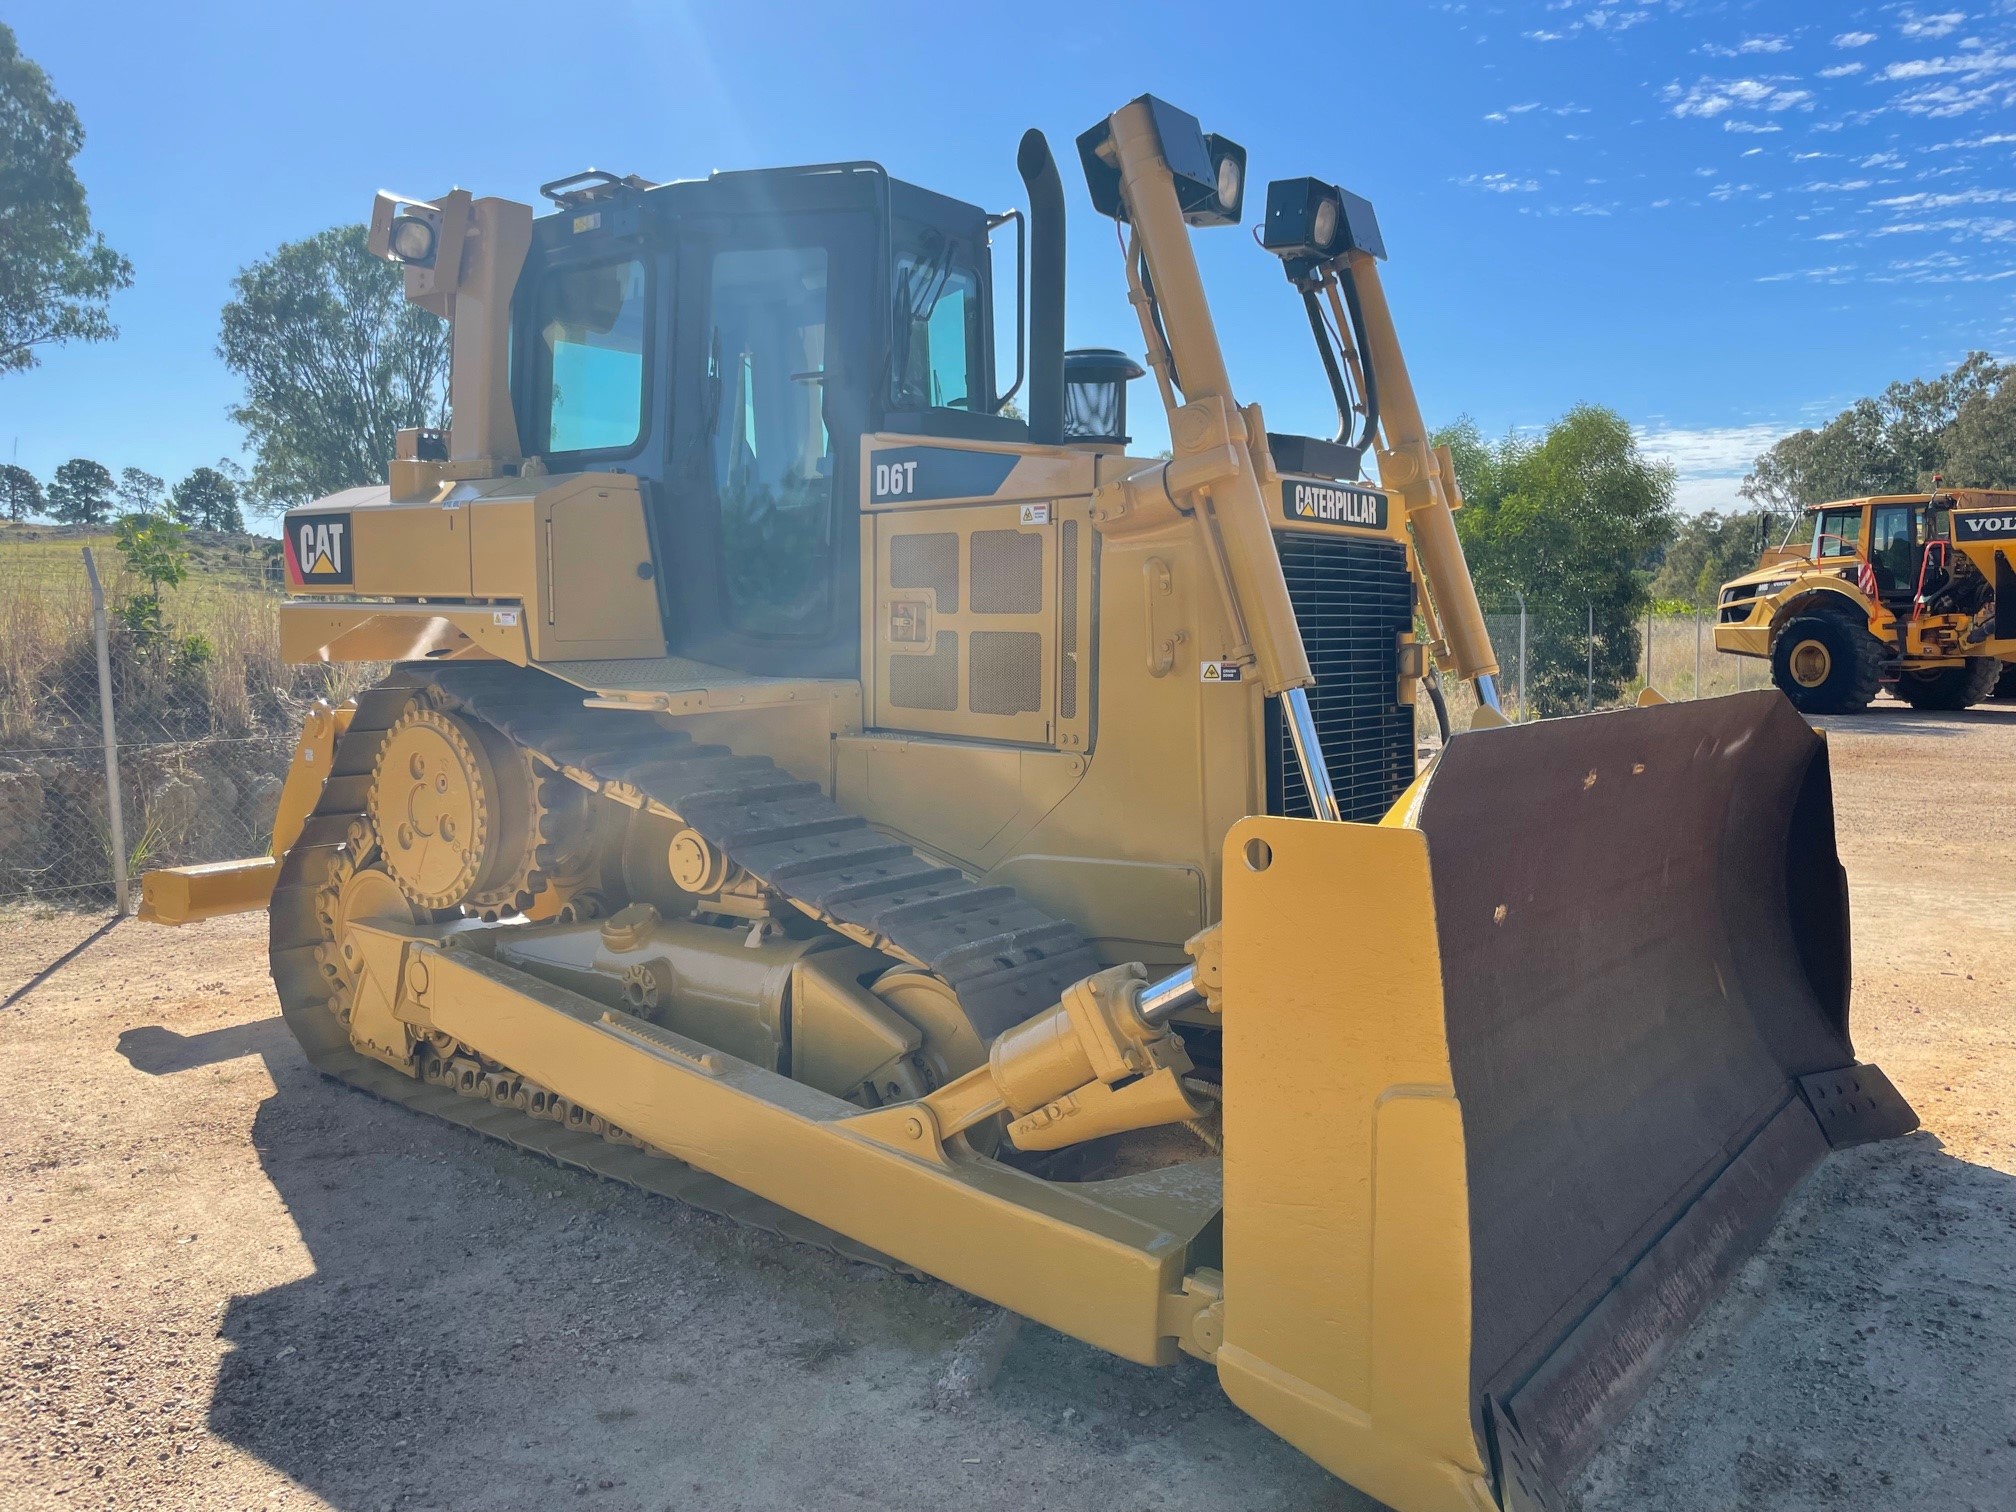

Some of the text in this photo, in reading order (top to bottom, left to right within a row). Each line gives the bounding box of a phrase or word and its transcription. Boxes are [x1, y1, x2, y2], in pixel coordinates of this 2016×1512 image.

[876, 461, 918, 496] D6T
[1295, 484, 1377, 525] CATERPILLAR
[1965, 517, 2016, 532] VOL
[300, 523, 344, 574] CAT
